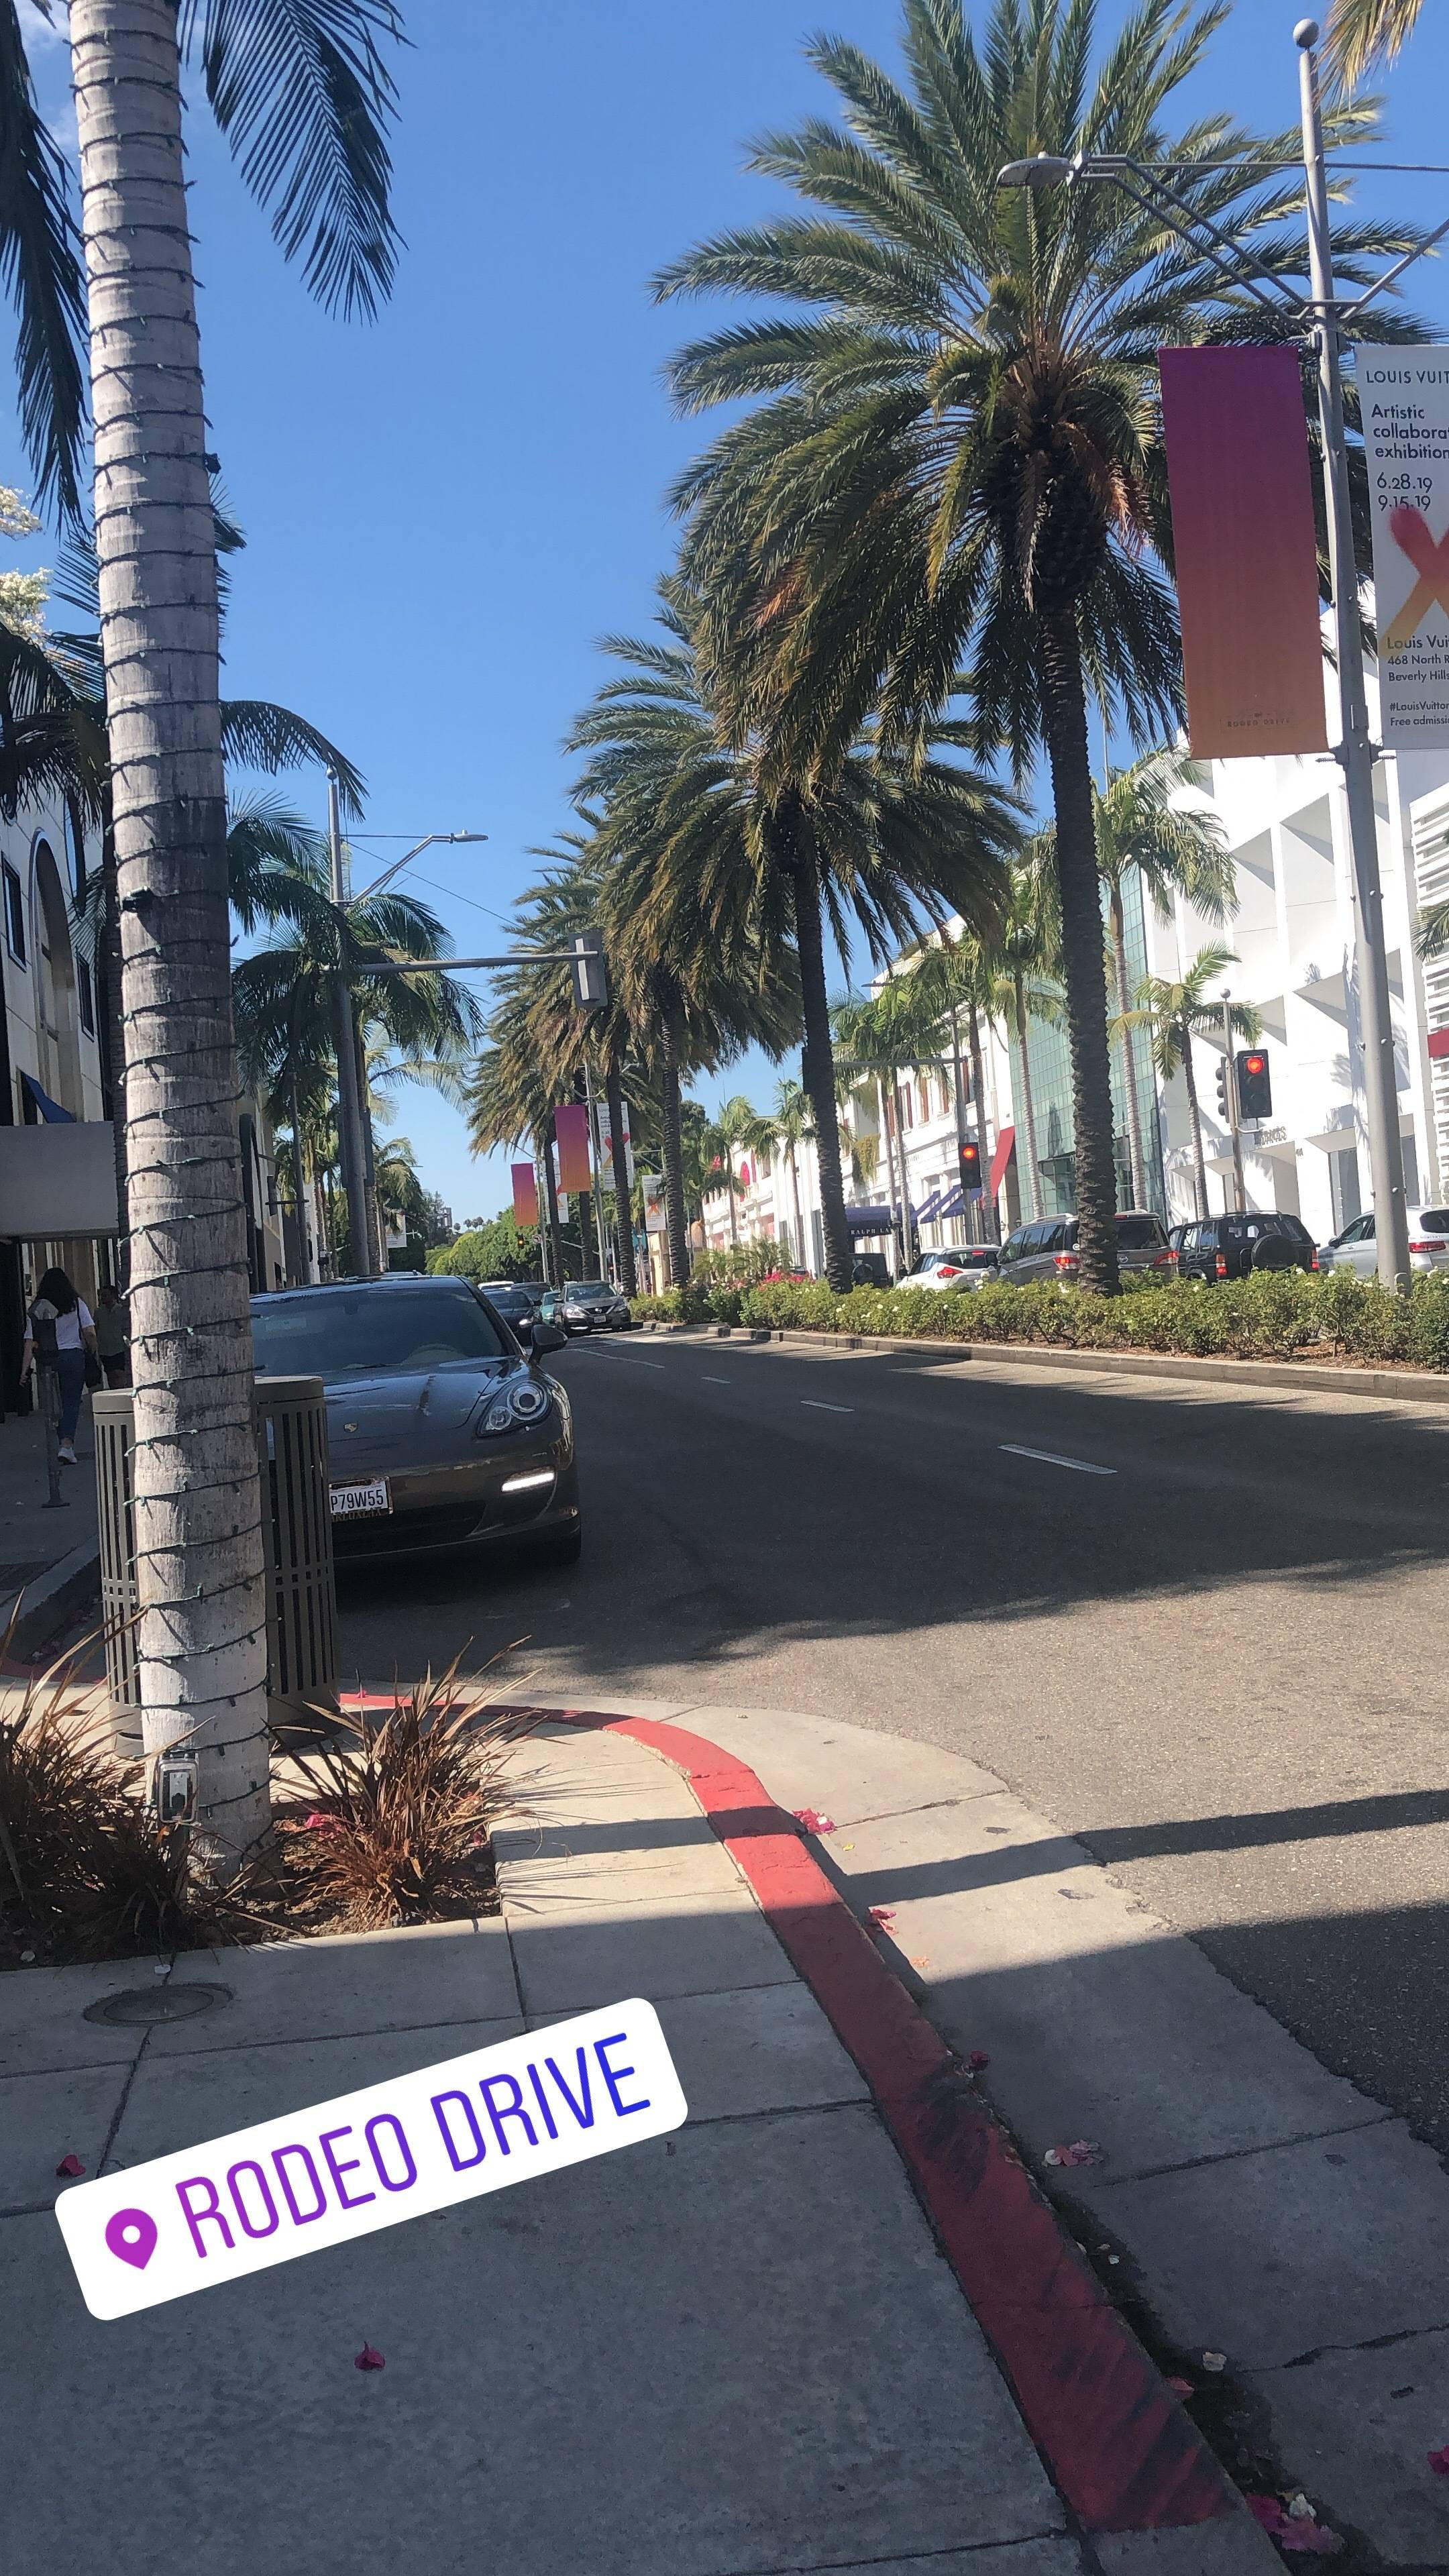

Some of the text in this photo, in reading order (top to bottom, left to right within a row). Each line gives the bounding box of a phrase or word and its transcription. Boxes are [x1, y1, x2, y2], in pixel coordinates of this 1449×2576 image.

[1366, 370, 1411, 384] LOUIS
[1371, 403, 1426, 419] Artistic
[1377, 472, 1433, 494] 6.28.19
[1378, 494, 1431, 512] 9.15.19
[1387, 635, 1423, 649] Louis
[1387, 655, 1408, 665] 468
[1411, 653, 1441, 665] North
[1389, 669, 1426, 683] Beverly
[1390, 717, 1411, 727] Free
[330, 1489, 384, 1511] P79W55
